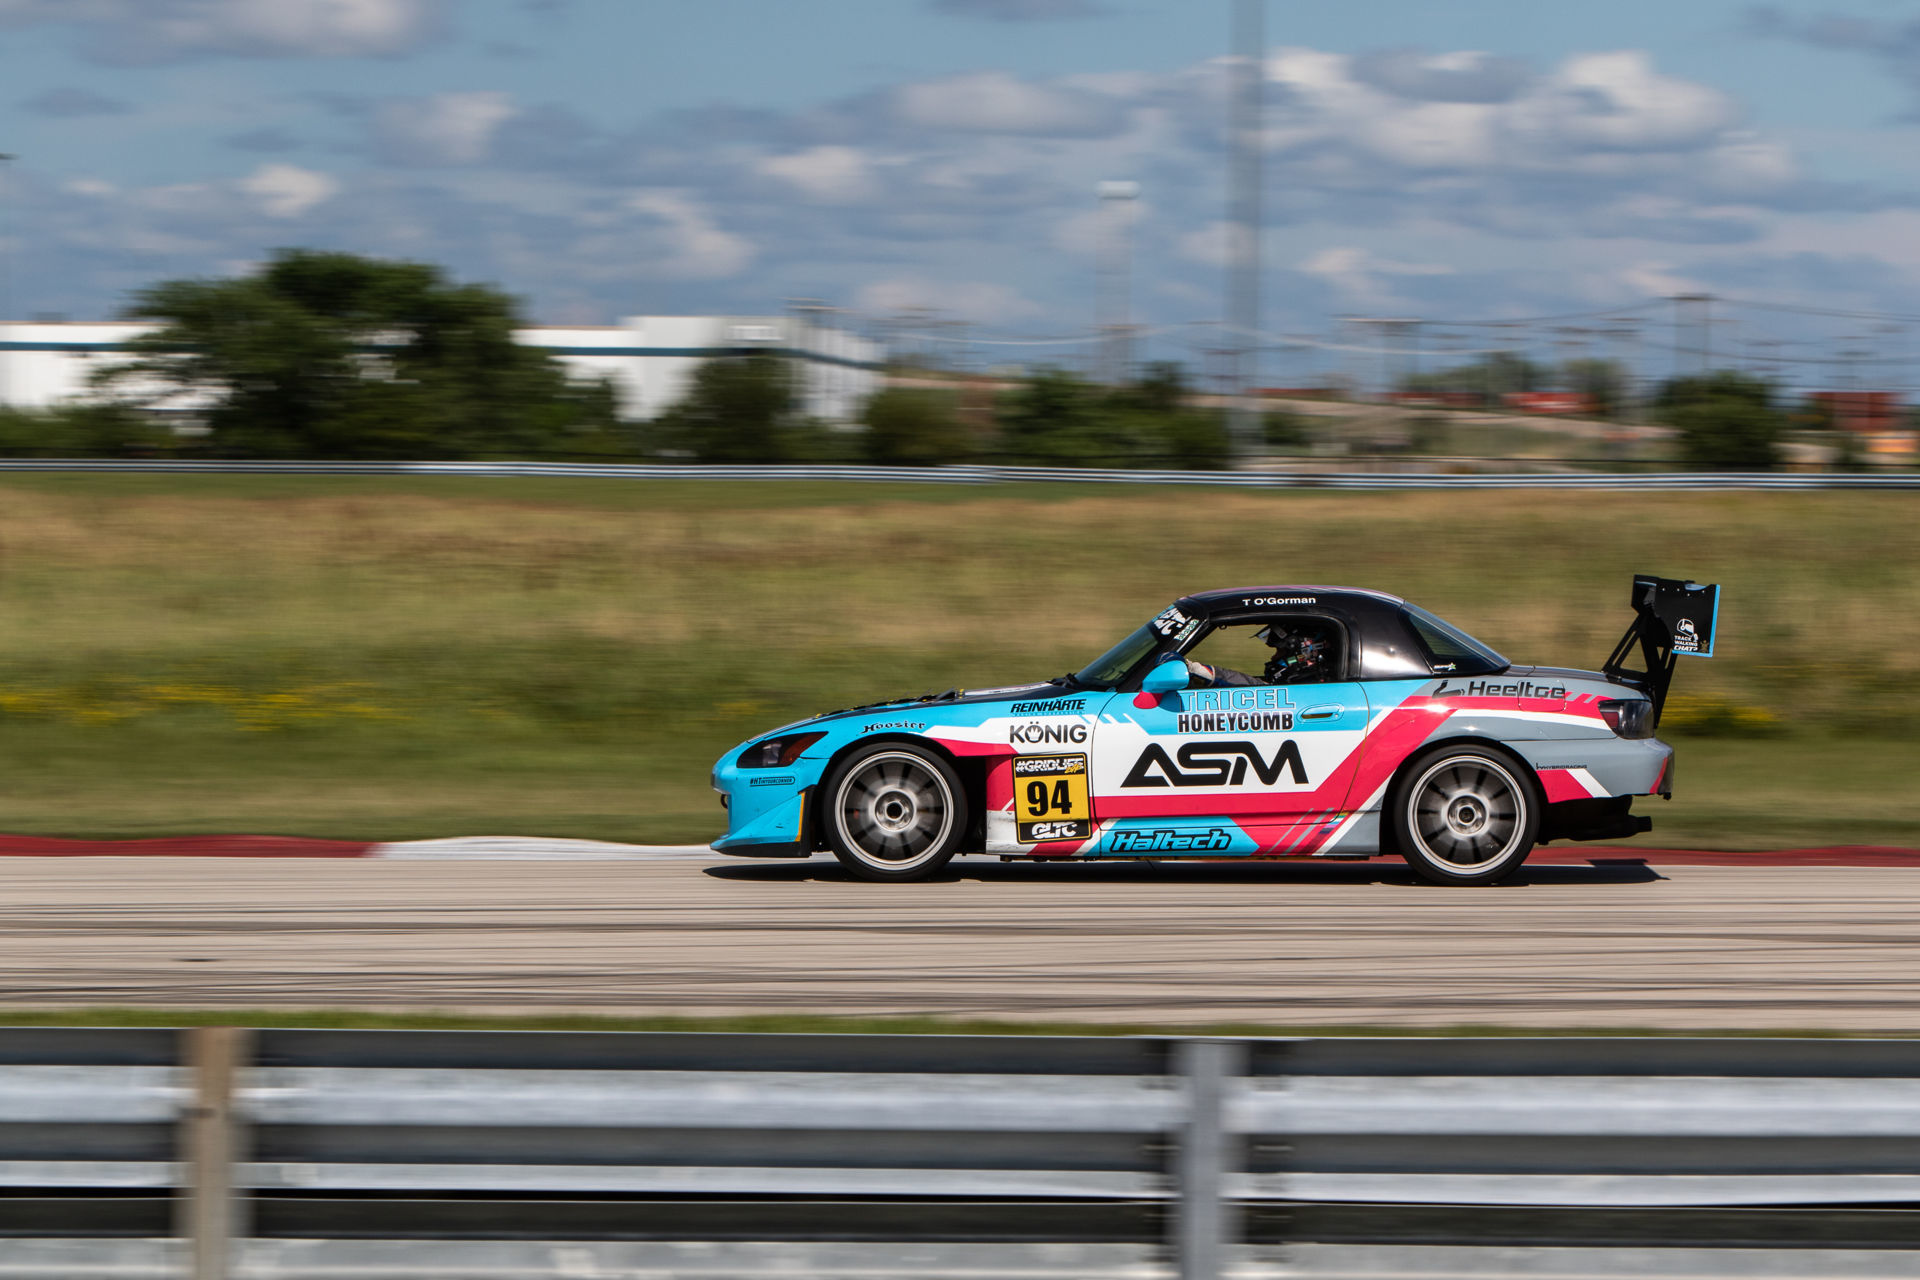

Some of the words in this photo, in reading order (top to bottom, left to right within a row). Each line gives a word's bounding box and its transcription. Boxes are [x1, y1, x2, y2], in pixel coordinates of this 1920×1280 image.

[1254, 597, 1316, 605] O'Gorman
[1010, 699, 1087, 713] REINHÄRTE
[1178, 688, 1296, 712] TRICEL
[861, 720, 926, 734] Hoosier
[1009, 721, 1088, 744] KÖNIG
[1177, 711, 1295, 734] HONEYCOMB
[1119, 739, 1310, 788] ASM
[1026, 780, 1073, 817] 94
[1110, 829, 1231, 852] Haltech
